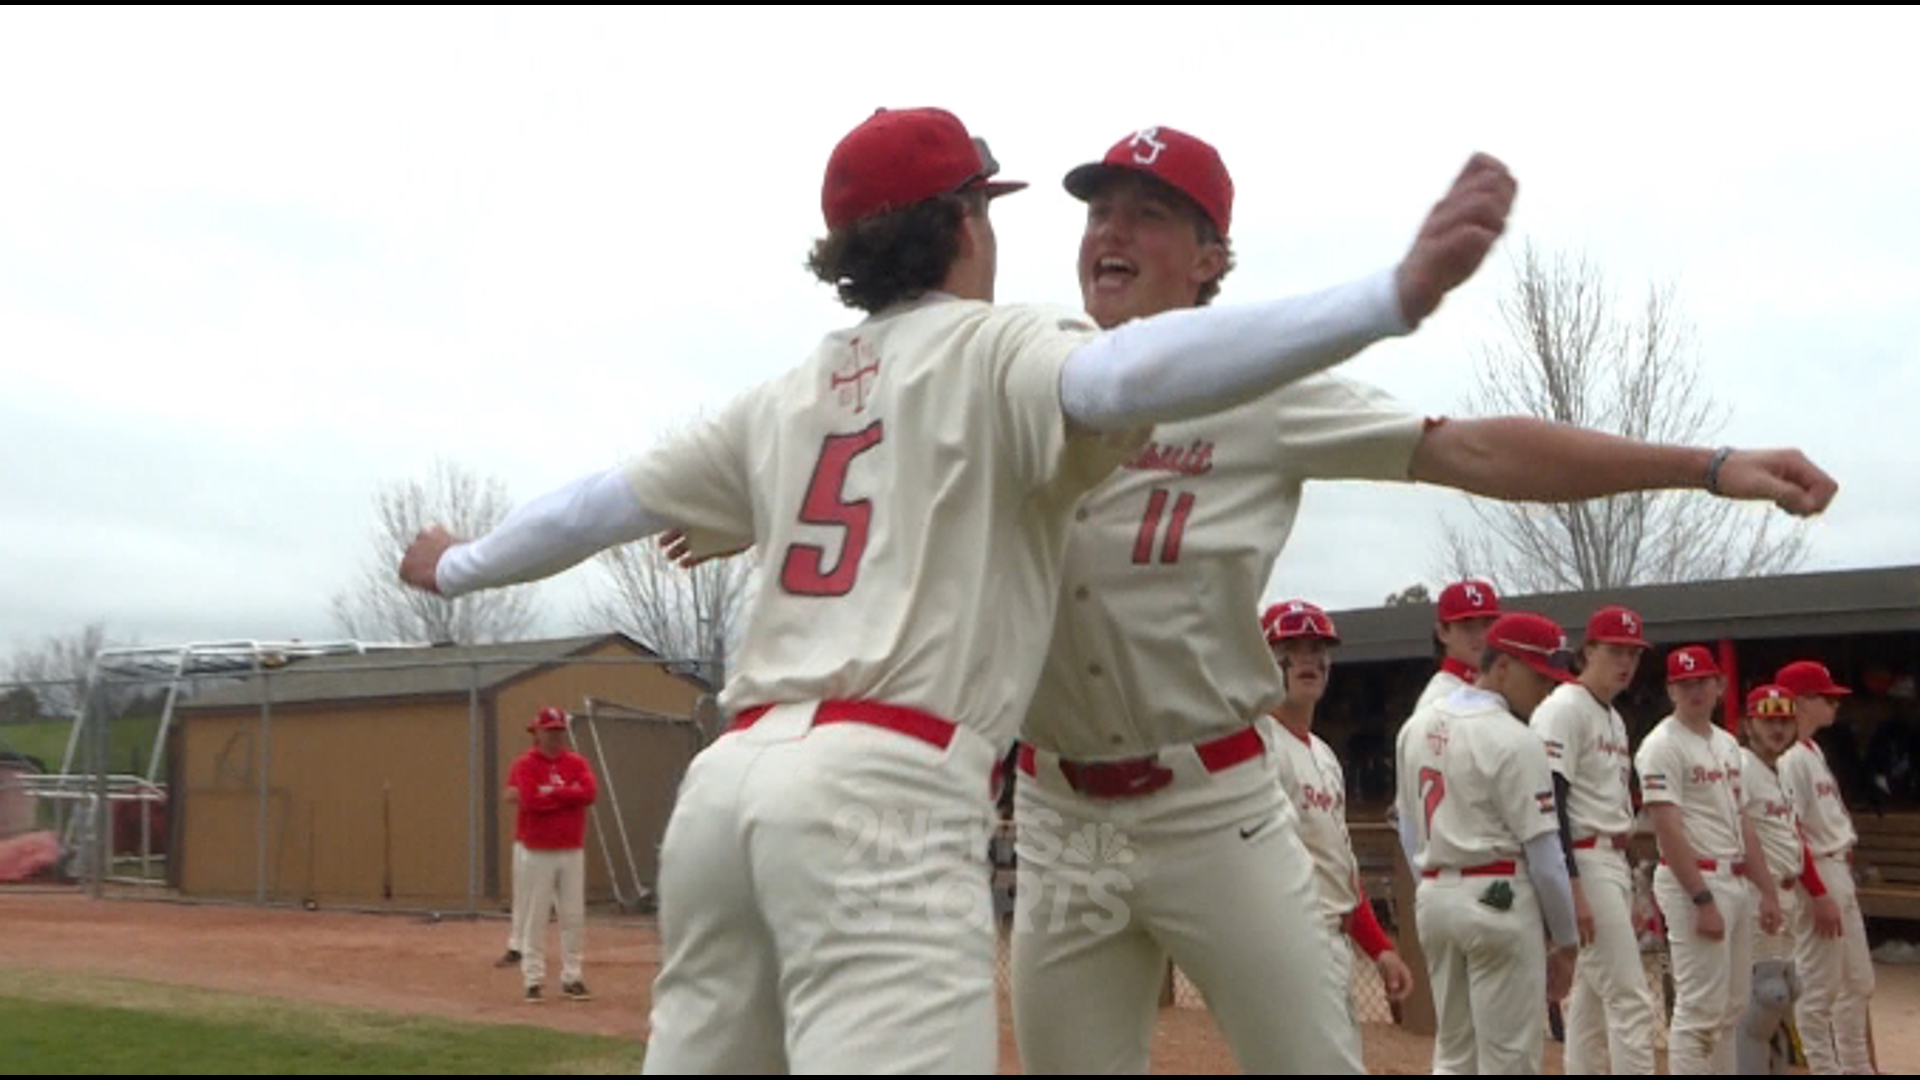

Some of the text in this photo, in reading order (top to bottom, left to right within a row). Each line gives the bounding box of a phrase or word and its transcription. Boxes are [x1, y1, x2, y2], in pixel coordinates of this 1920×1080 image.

[780, 419, 884, 597] 5
[1131, 488, 1196, 565] 11
[1418, 766, 1446, 841] 7
